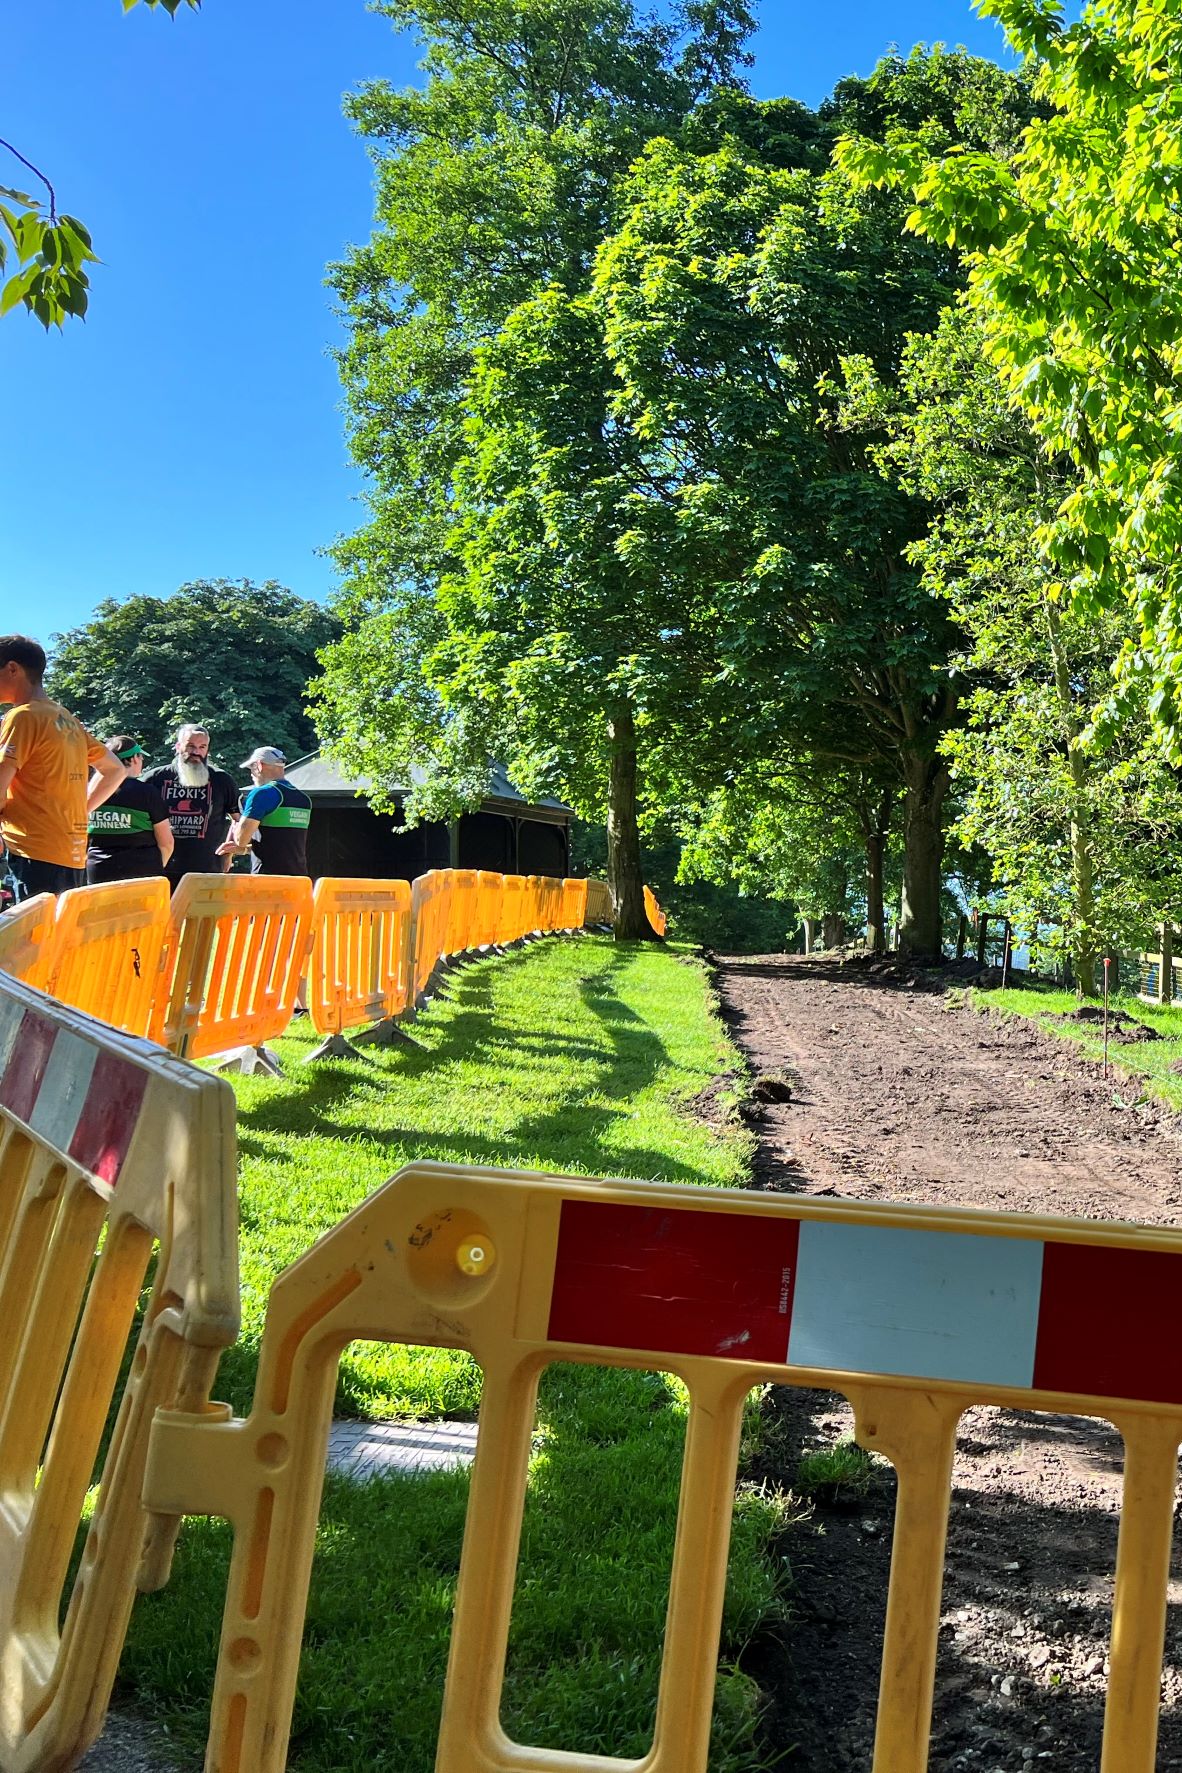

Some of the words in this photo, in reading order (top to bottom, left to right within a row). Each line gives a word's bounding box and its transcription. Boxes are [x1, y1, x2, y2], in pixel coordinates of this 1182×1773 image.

[166, 788, 206, 799] FLOKI'S
[89, 811, 131, 824] VEGAN
[169, 815, 204, 825] HIPYARD
